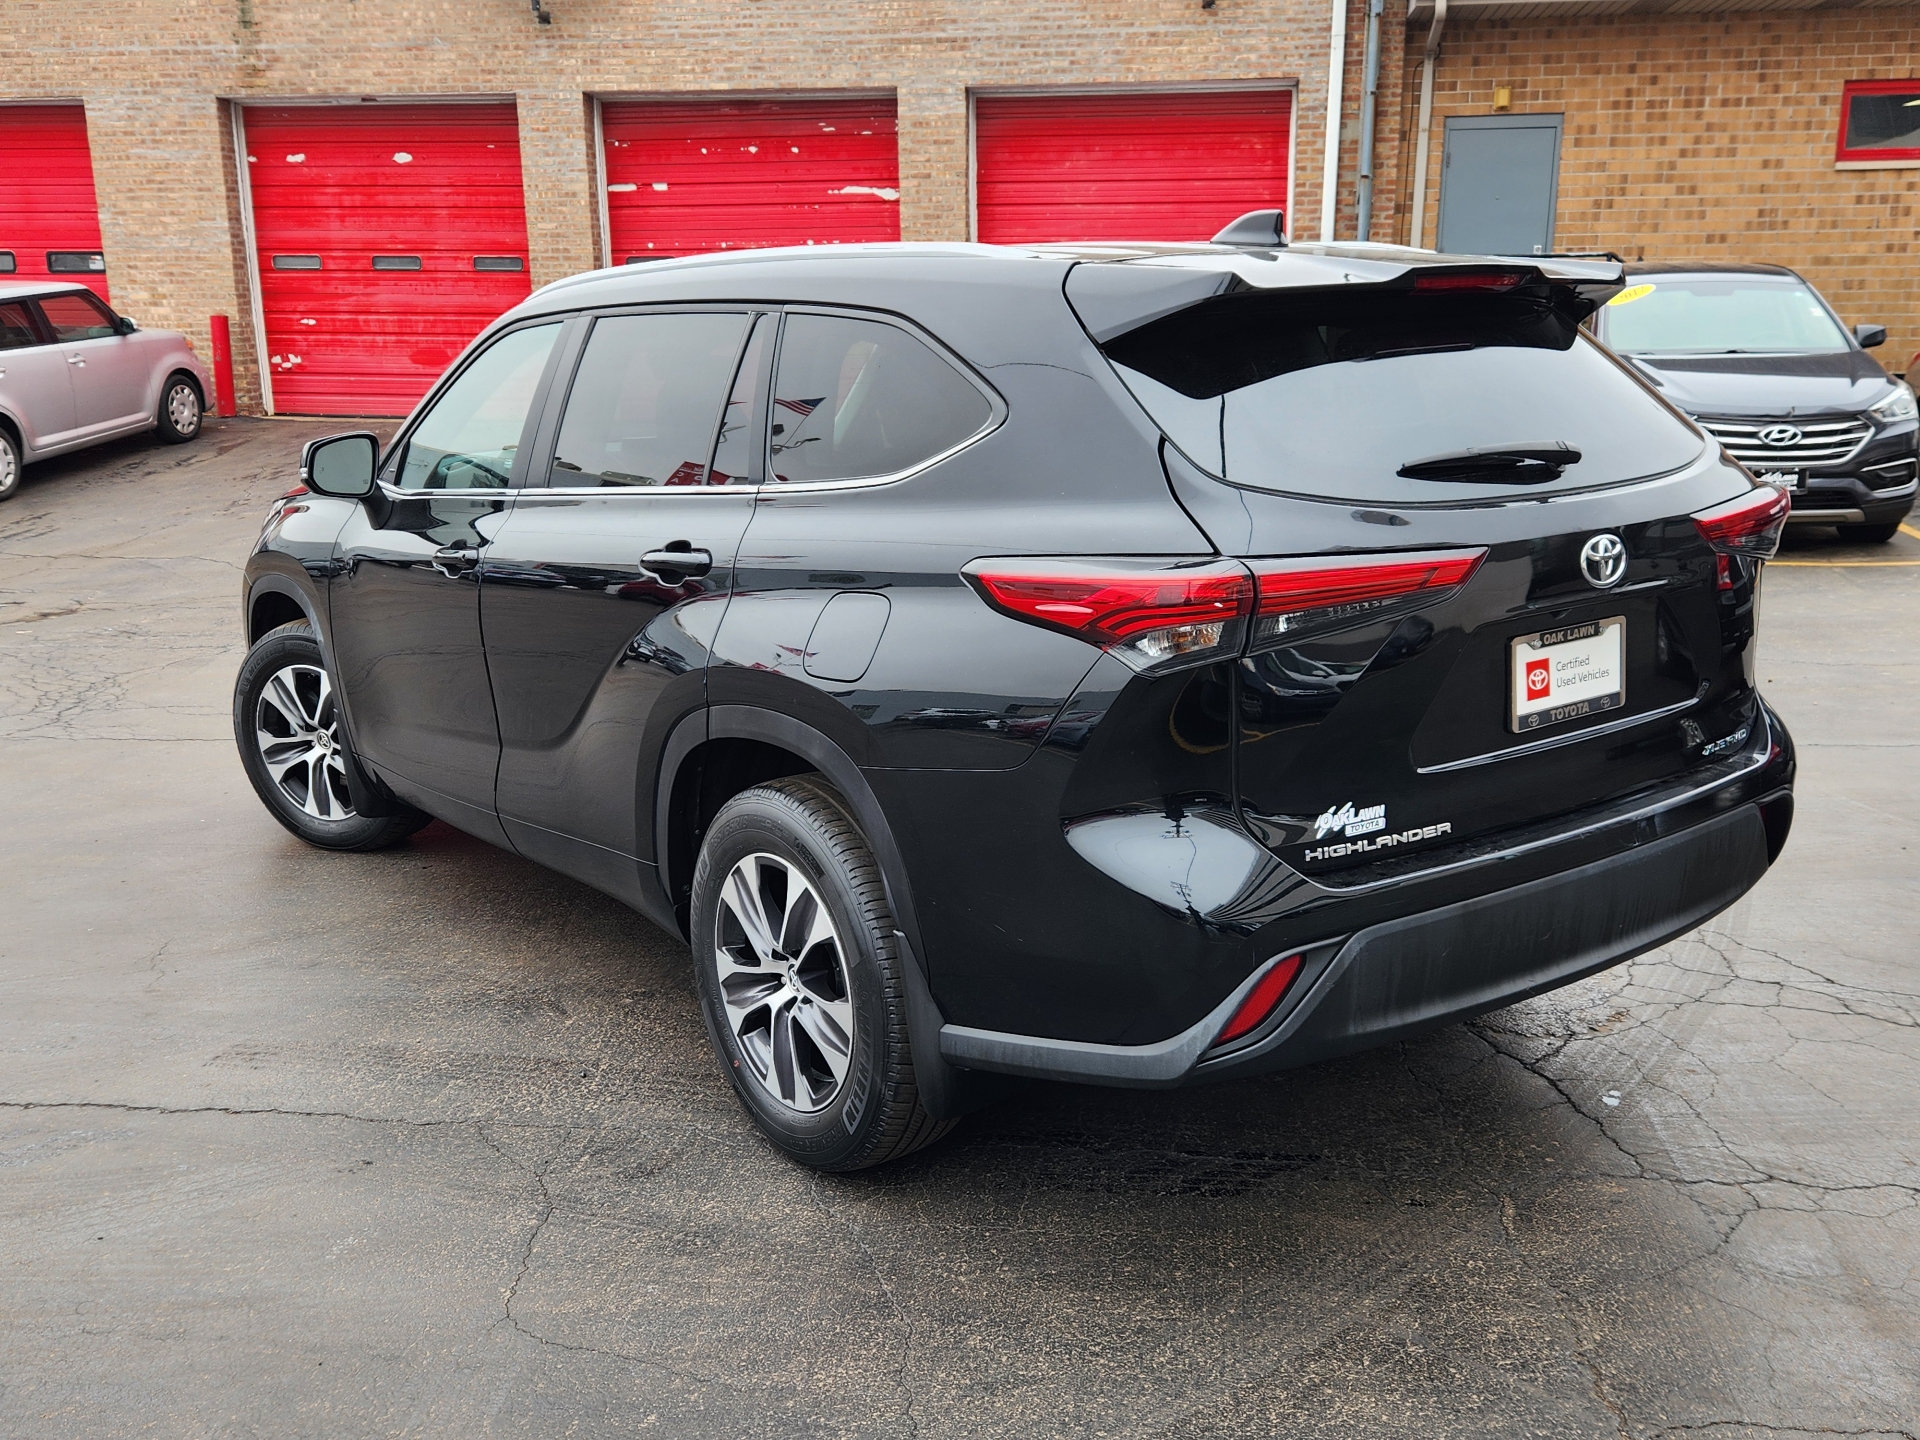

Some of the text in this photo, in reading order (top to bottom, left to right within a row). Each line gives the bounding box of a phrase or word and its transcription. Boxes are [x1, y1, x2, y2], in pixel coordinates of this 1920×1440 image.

[1543, 624, 1595, 645] OAK LAWN
[1556, 654, 1590, 672] Certified
[1556, 668, 1610, 688] Used Vehicles
[1549, 701, 1590, 721] TOYOTA
[1350, 820, 1380, 833] TOYOTA
[1304, 822, 1452, 862] HIGHLANDER
